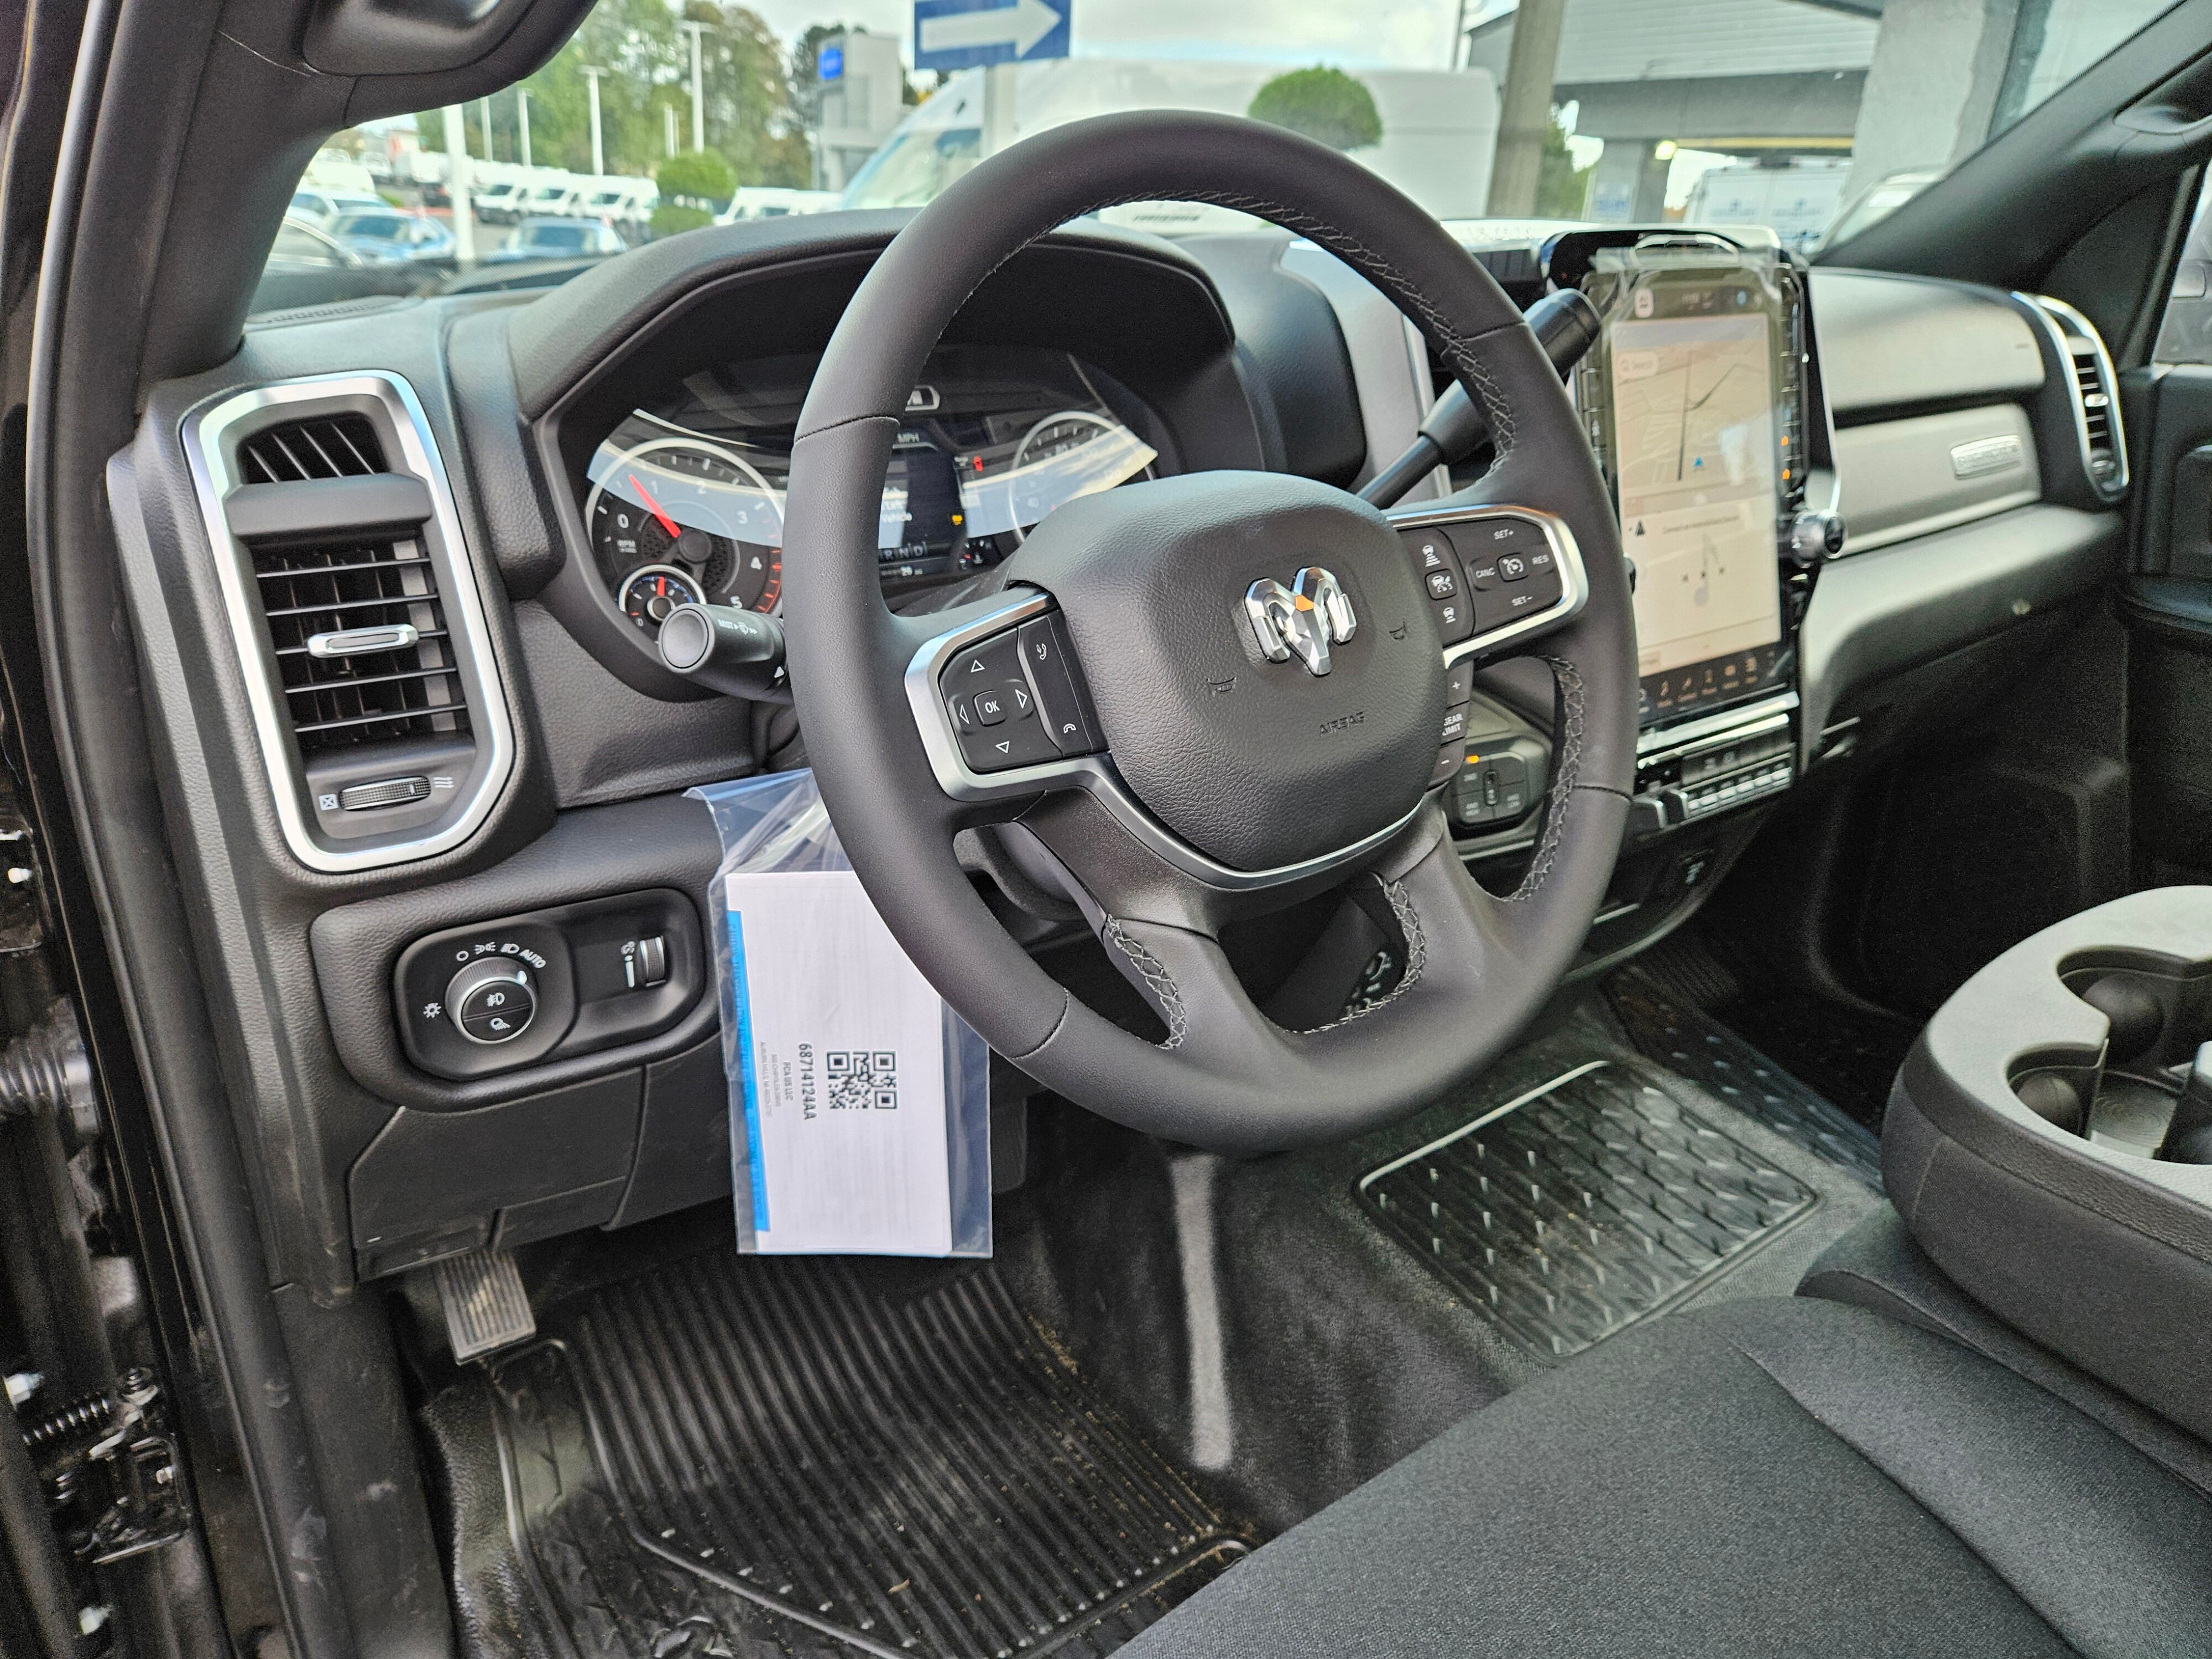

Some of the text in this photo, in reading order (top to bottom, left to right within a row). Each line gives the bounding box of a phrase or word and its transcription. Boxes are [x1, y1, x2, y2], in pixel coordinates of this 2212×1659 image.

[897, 432, 920, 443] MPH
[651, 480, 659, 495] 1
[697, 481, 707, 494] 2
[617, 513, 629, 529] 0
[737, 510, 748, 524] 3
[750, 556, 763, 570] 4
[1532, 554, 1549, 565] RES
[730, 596, 743, 609] 5
[985, 700, 1000, 713] OK
[1319, 711, 1366, 737] AIRBAG
[518, 949, 546, 968] AUTO
[783, 1062, 794, 1100] FCA US LLC
[799, 1042, 817, 1120] 68714124AA
